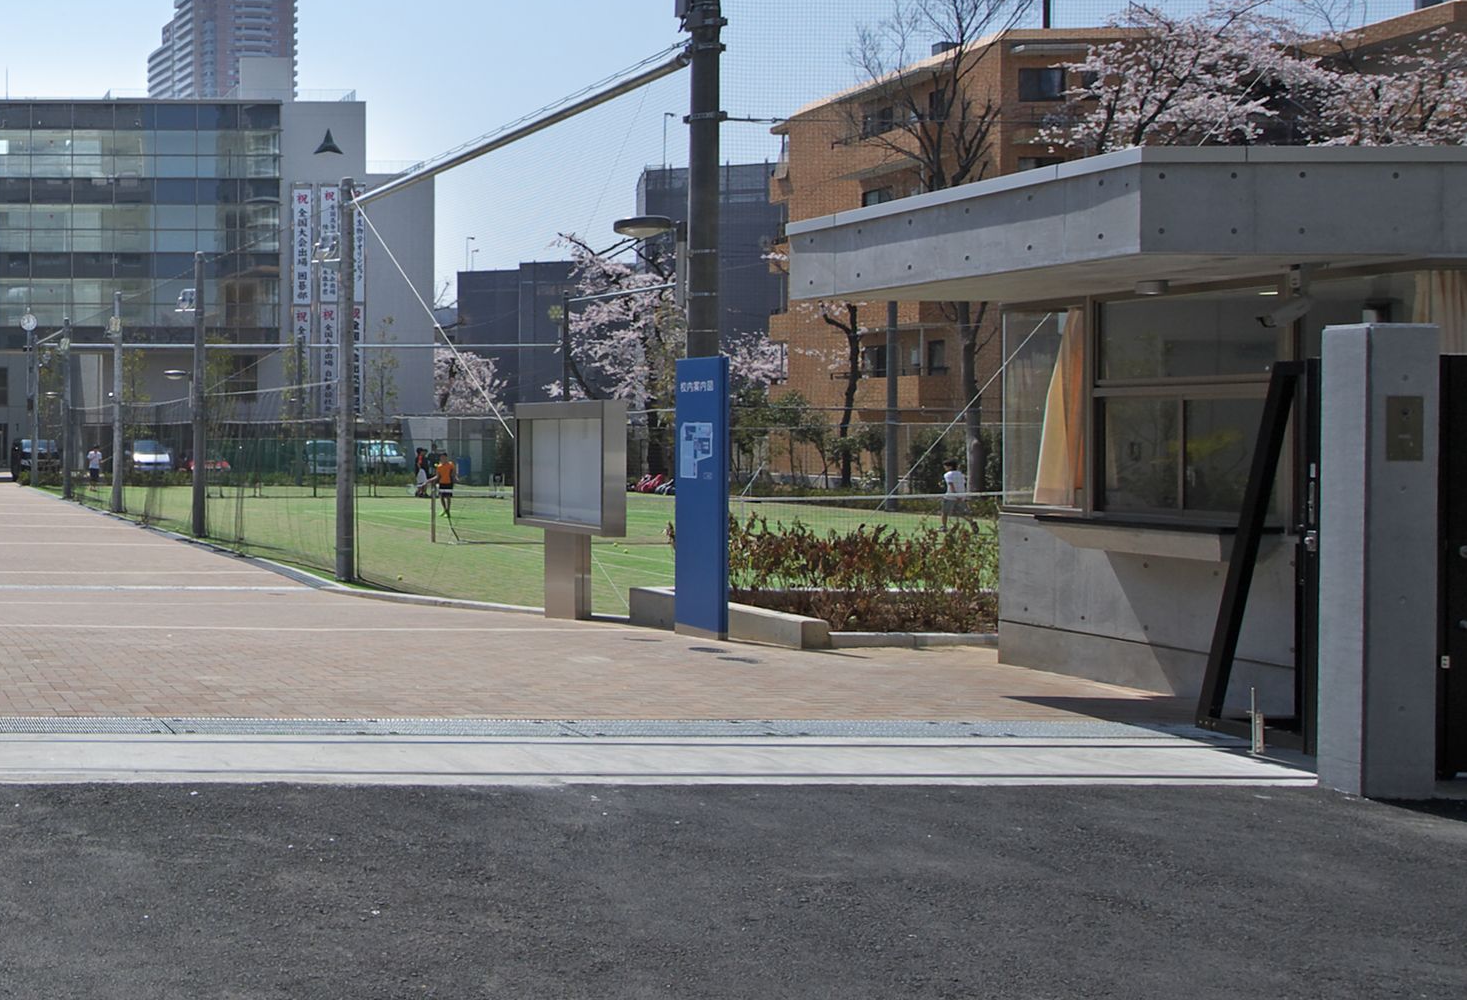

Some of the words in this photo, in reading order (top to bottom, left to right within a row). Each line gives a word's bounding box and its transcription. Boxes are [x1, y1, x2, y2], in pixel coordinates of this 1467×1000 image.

[297, 193, 308, 205] 祝
[325, 190, 335, 201] 祝
[297, 310, 308, 322] 祝
